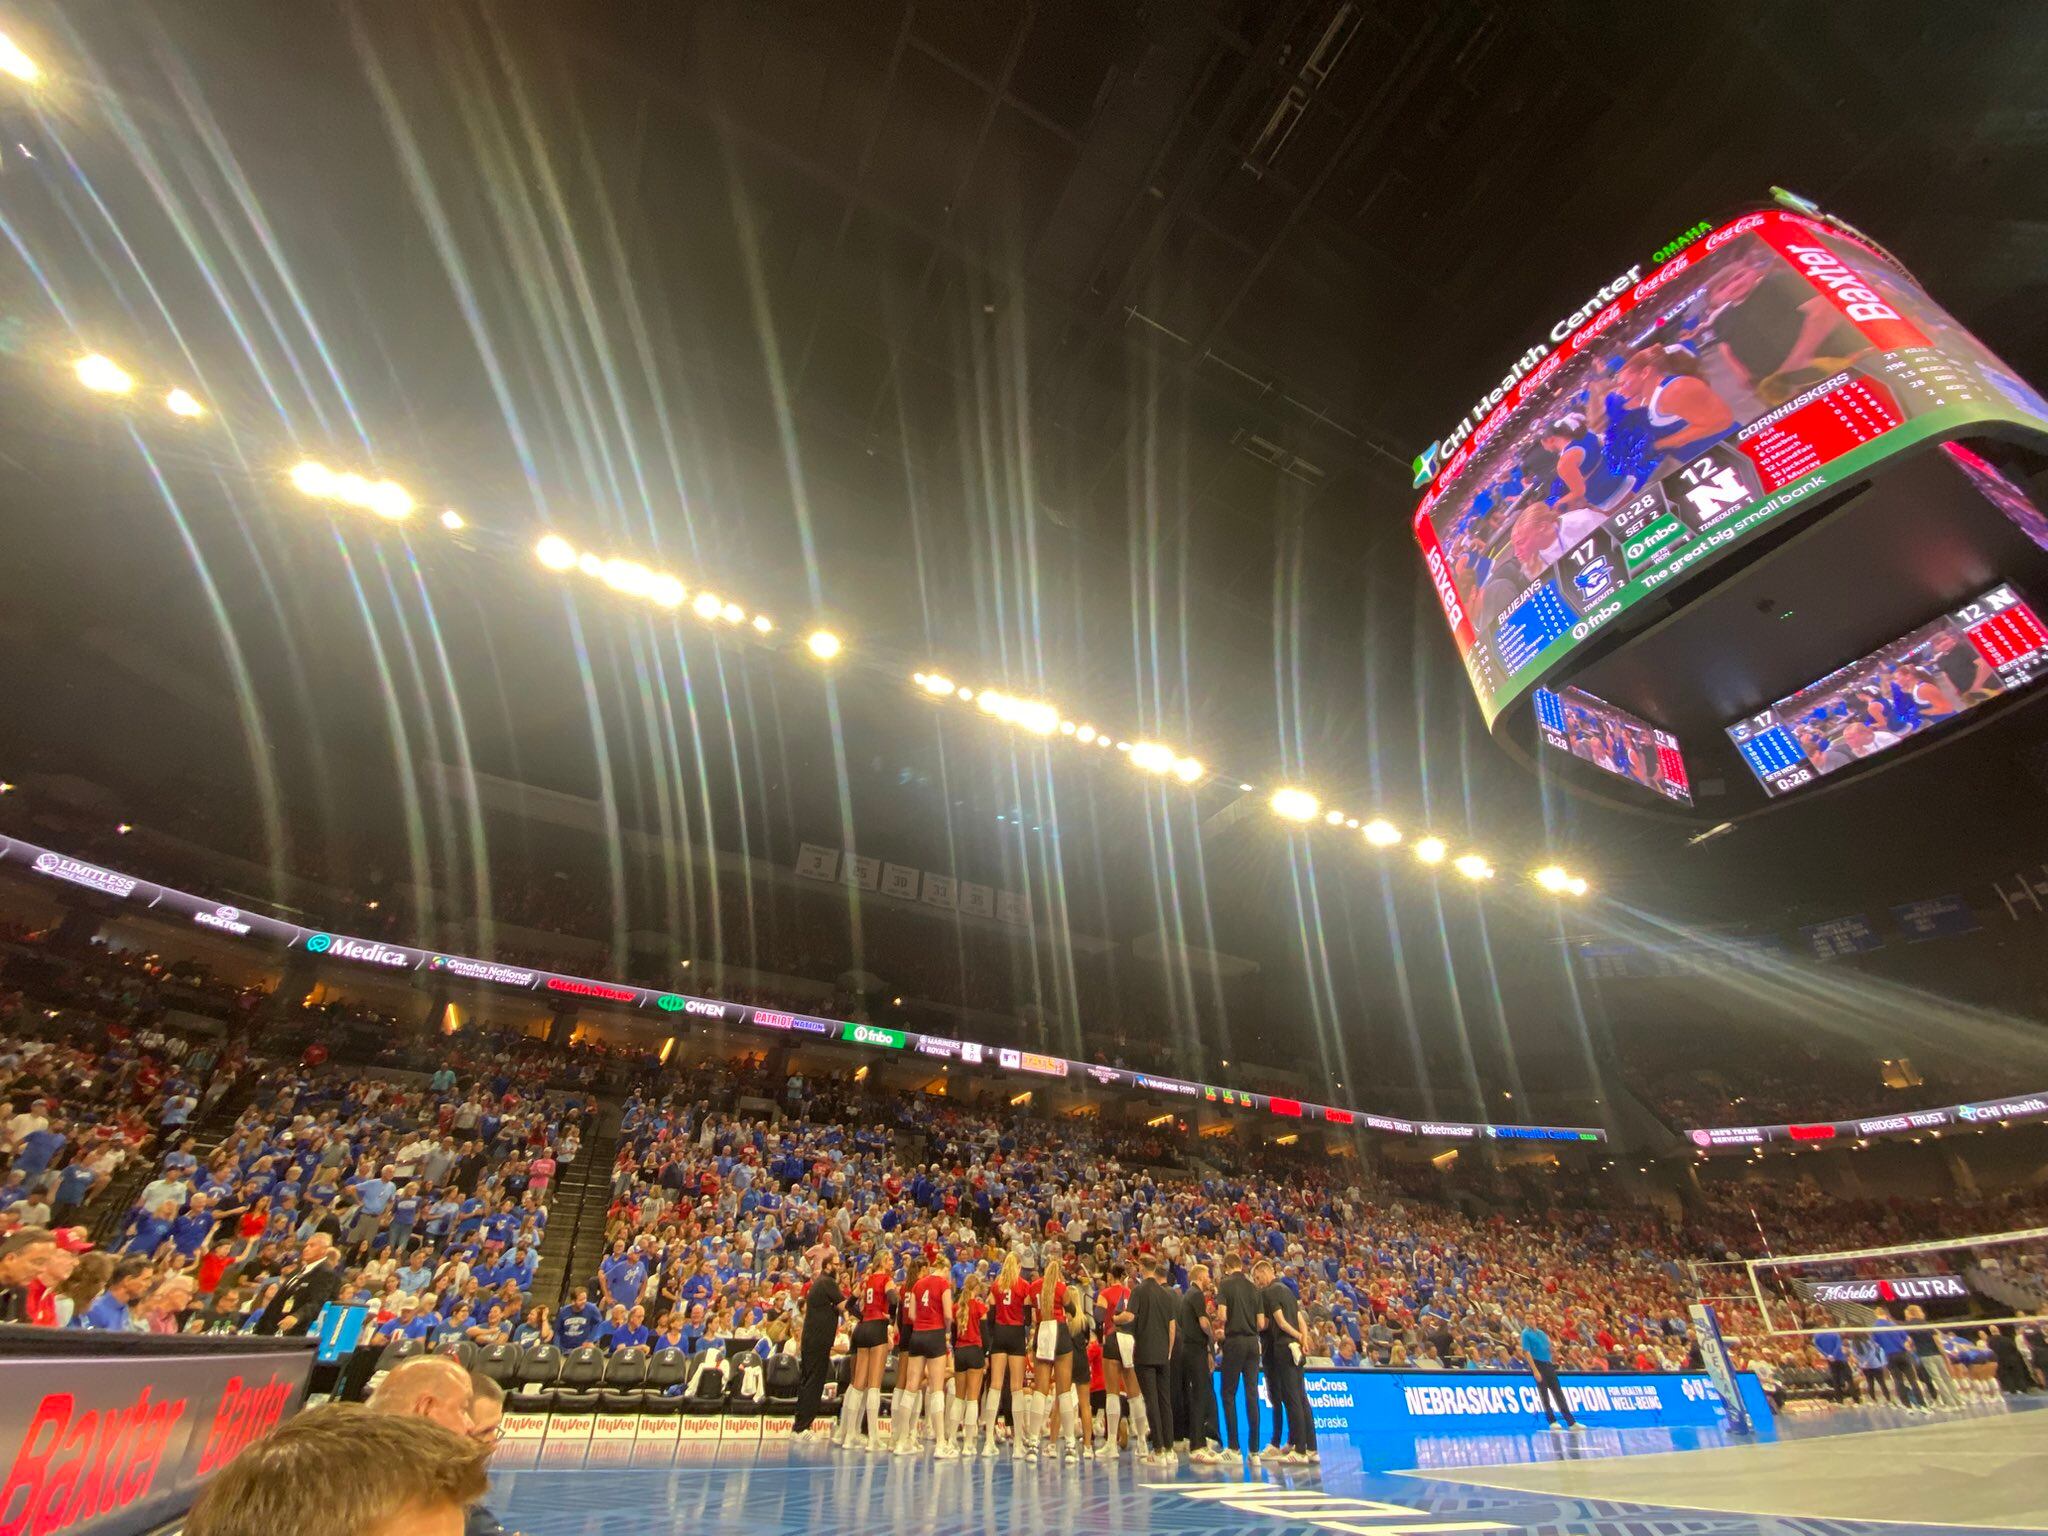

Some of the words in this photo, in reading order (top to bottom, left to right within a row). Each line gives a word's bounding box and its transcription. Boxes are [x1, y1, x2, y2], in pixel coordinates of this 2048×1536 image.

[1652, 220, 1712, 263] OMAHA
[1786, 244, 1902, 322] Baxter
[1440, 417, 1473, 460] CHI
[1473, 344, 1549, 420] Health
[1550, 264, 1641, 342] Center
[1738, 372, 1850, 441] CORNHUSKERS
[1680, 457, 1719, 485] 12
[1781, 452, 1817, 474] Jackson
[1787, 459, 1821, 481] Murray
[1614, 494, 1656, 527] 0:28
[1698, 503, 1741, 532] TIMEOUTS
[1625, 519, 1646, 538] SET
[1649, 510, 1660, 520] 2
[1641, 564, 1668, 588] The
[1669, 541, 1708, 577] great
[1710, 527, 1736, 546] big
[1735, 499, 1779, 531] small
[1779, 475, 1826, 504] bank
[1644, 522, 1679, 549] fnbo
[1570, 538, 1595, 567] 17
[1427, 545, 1464, 632] Baxter
[1582, 586, 1615, 613] TIMEOUTS
[1616, 579, 1625, 588] 2
[1497, 578, 1542, 625] BLUEJAYS
[1587, 601, 1622, 627] fnbo
[1956, 604, 1986, 622] 12
[1753, 711, 1772, 727] 17
[1547, 733, 1569, 750] 0:28
[1777, 769, 1811, 790] 0:28
[813, 857, 822, 870] 3
[59, 860, 137, 891] LIMITLESS
[447, 959, 488, 974] Omaha
[454, 969, 494, 980] INSURANCE
[495, 975, 529, 985] COMPANY
[685, 1000, 724, 1017] OWEN
[754, 1011, 794, 1029] PATRIOT
[868, 1028, 893, 1045] fnbo
[927, 1036, 960, 1050] MARINERS
[926, 1046, 951, 1057] ROYALS
[1977, 1106, 2000, 1118] CHI
[2001, 1099, 2046, 1115] Health
[1367, 1117, 1393, 1130] BRIDGES
[1393, 1121, 1413, 1133] TRUST
[1421, 1124, 1474, 1136] ticketmaster
[1859, 1117, 1908, 1132] BRIDGES
[866, 1288, 873, 1304] 8
[921, 1289, 929, 1306] 4
[1003, 1287, 1011, 1305] 3
[1814, 1285, 1879, 1302] Michelob
[1893, 1279, 1966, 1298] ULTRA
[1304, 1377, 1348, 1392] lueCross
[1307, 1393, 1354, 1408] lueShield
[1406, 1386, 1520, 1416] NEBRASKA'S
[1611, 1396, 1662, 1410] WELL-BEING
[1313, 1415, 1348, 1429] ebraska
[0, 1385, 187, 1536] Baxter
